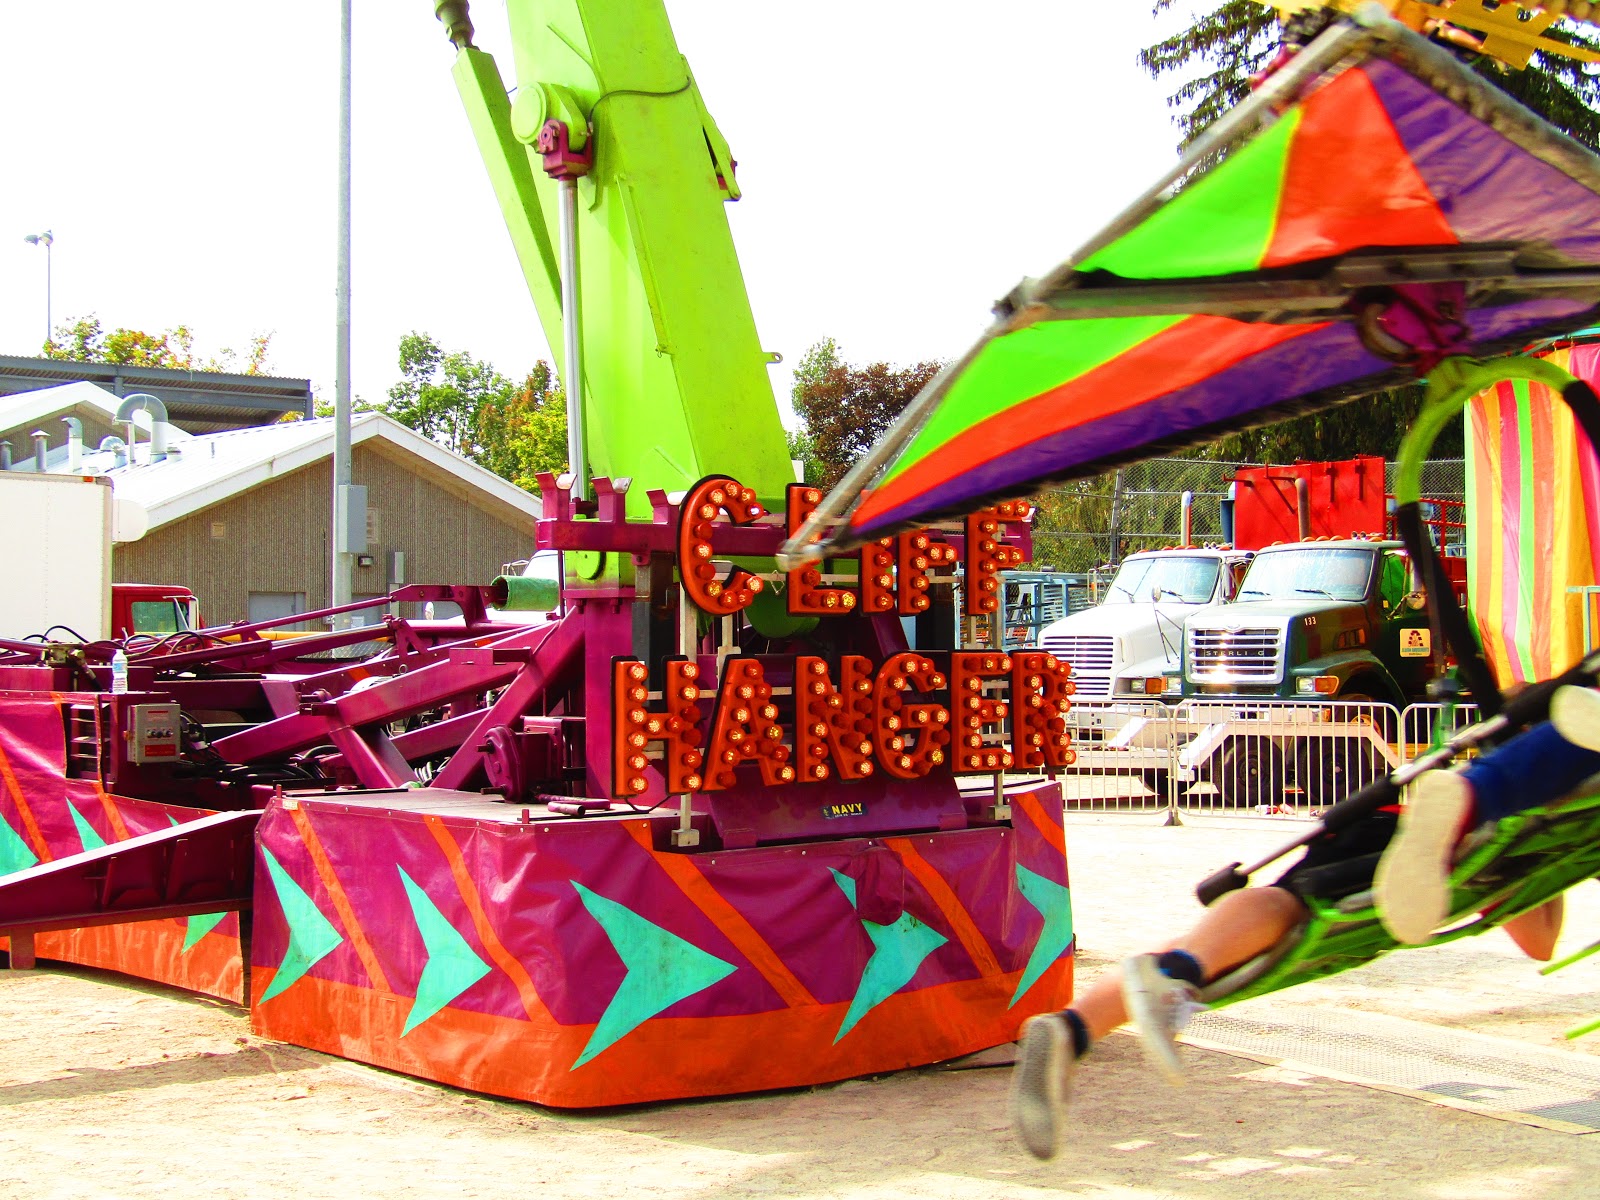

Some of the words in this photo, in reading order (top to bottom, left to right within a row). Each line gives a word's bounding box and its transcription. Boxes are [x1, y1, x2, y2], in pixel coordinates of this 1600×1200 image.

[1304, 616, 1317, 626] 133
[613, 652, 1076, 796] HANGER
[831, 802, 862, 815] NAVY
